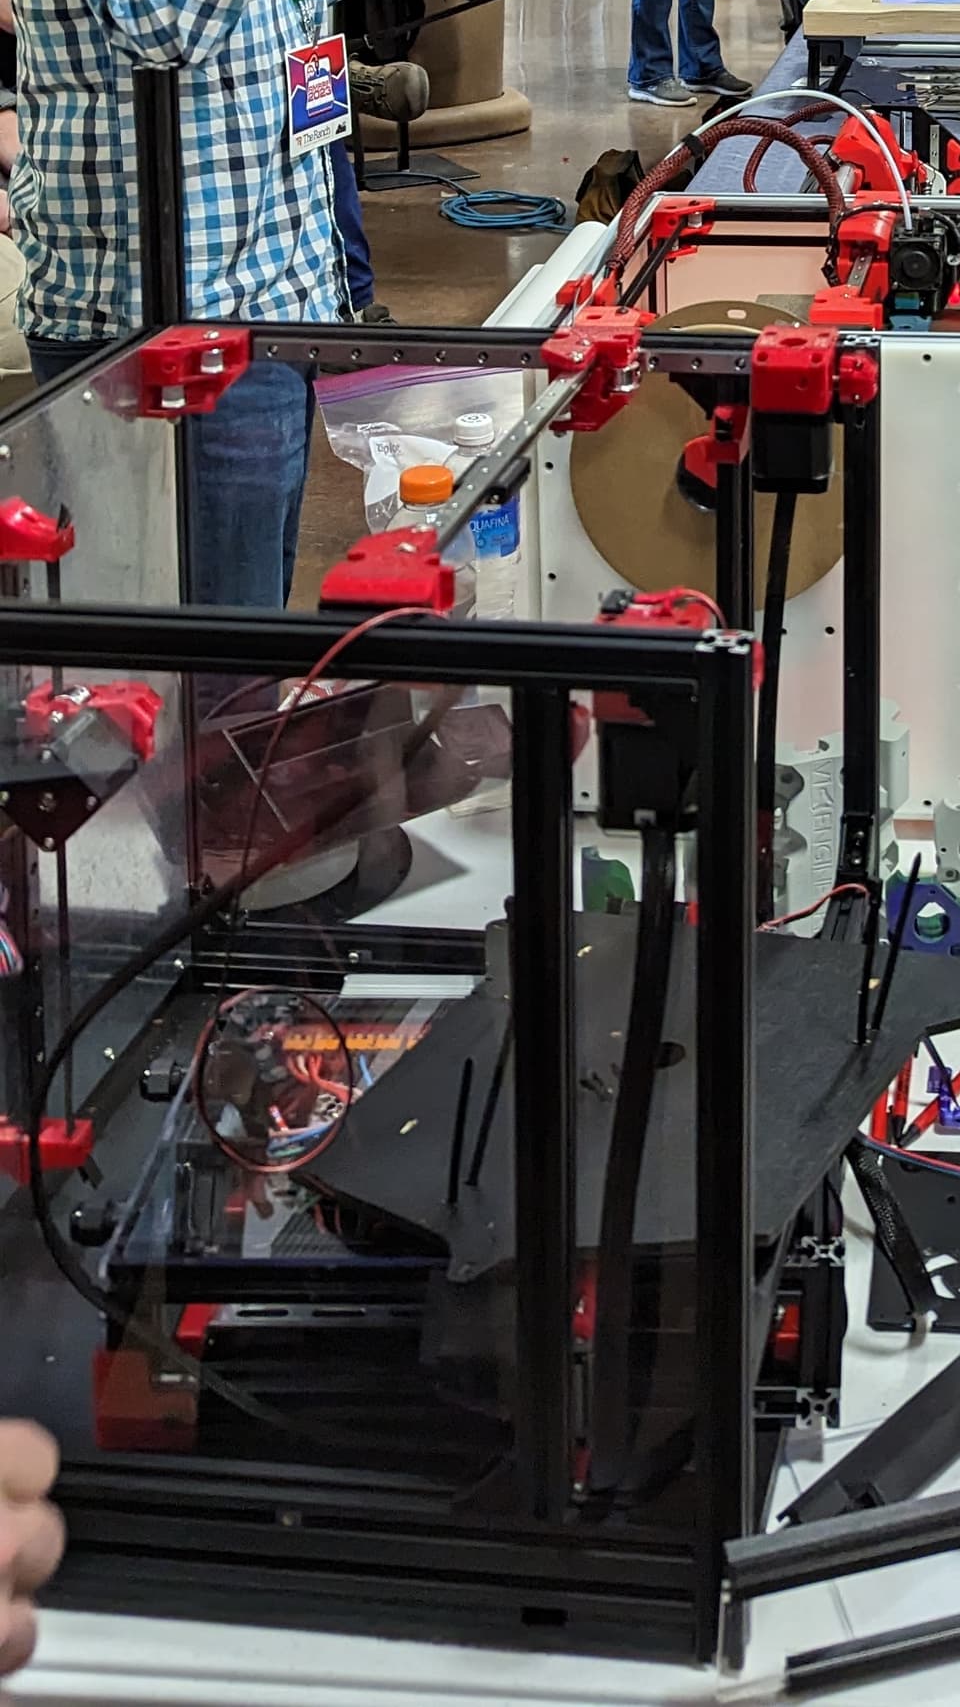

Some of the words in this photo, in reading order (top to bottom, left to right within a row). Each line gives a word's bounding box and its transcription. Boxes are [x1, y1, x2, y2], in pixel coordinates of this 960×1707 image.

[308, 86, 332, 103] 2023
[303, 131, 315, 144] The
[313, 125, 331, 142] Ranch
[469, 513, 510, 533] QUAFINA
